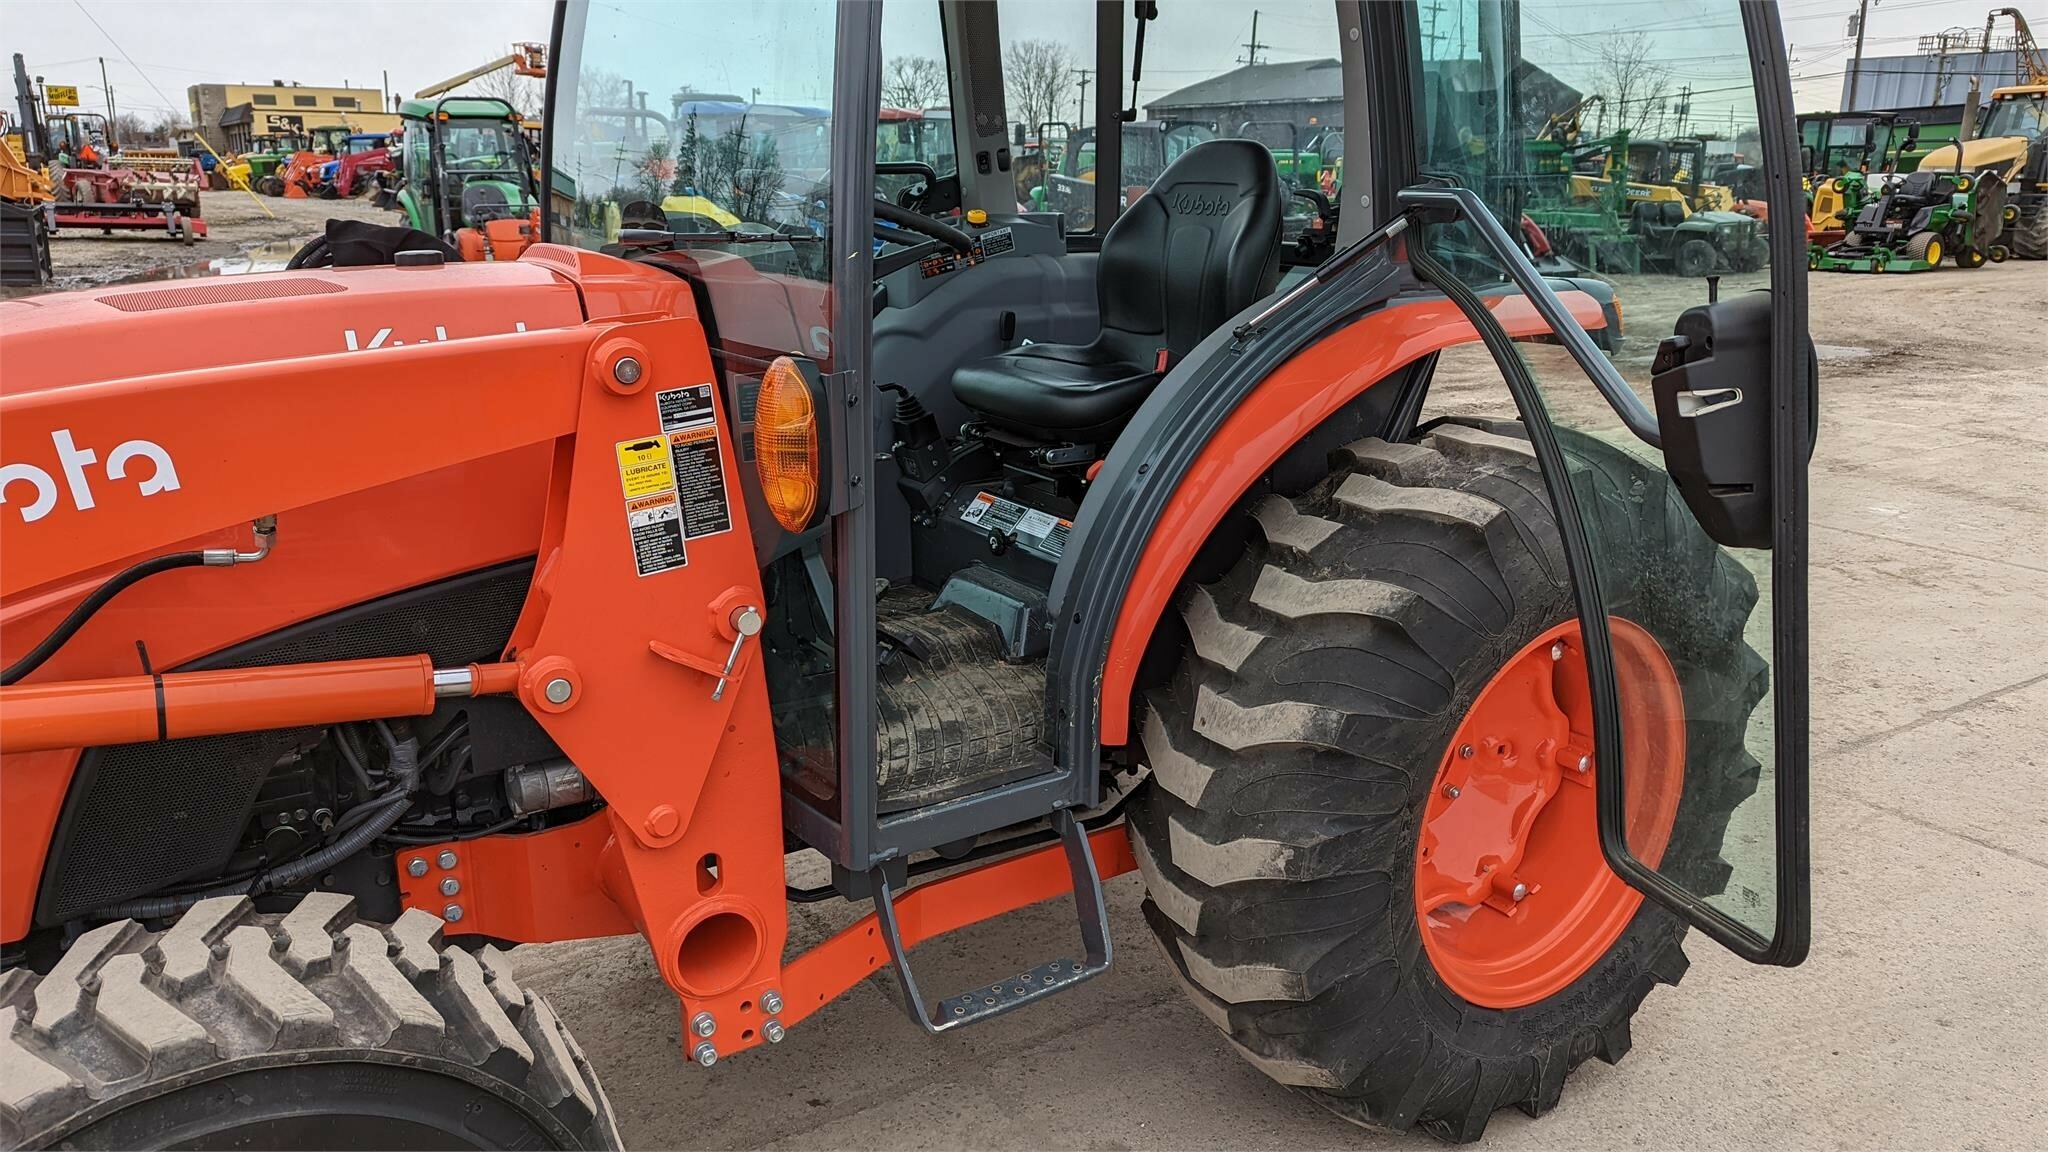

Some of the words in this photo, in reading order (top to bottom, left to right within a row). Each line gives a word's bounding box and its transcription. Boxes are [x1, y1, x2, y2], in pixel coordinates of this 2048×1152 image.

[1171, 193, 1230, 216] Kubota
[659, 391, 689, 401] Kubota
[680, 429, 714, 441] WARNING
[626, 463, 666, 475] LUBRICATE
[638, 495, 673, 507] WARNING
